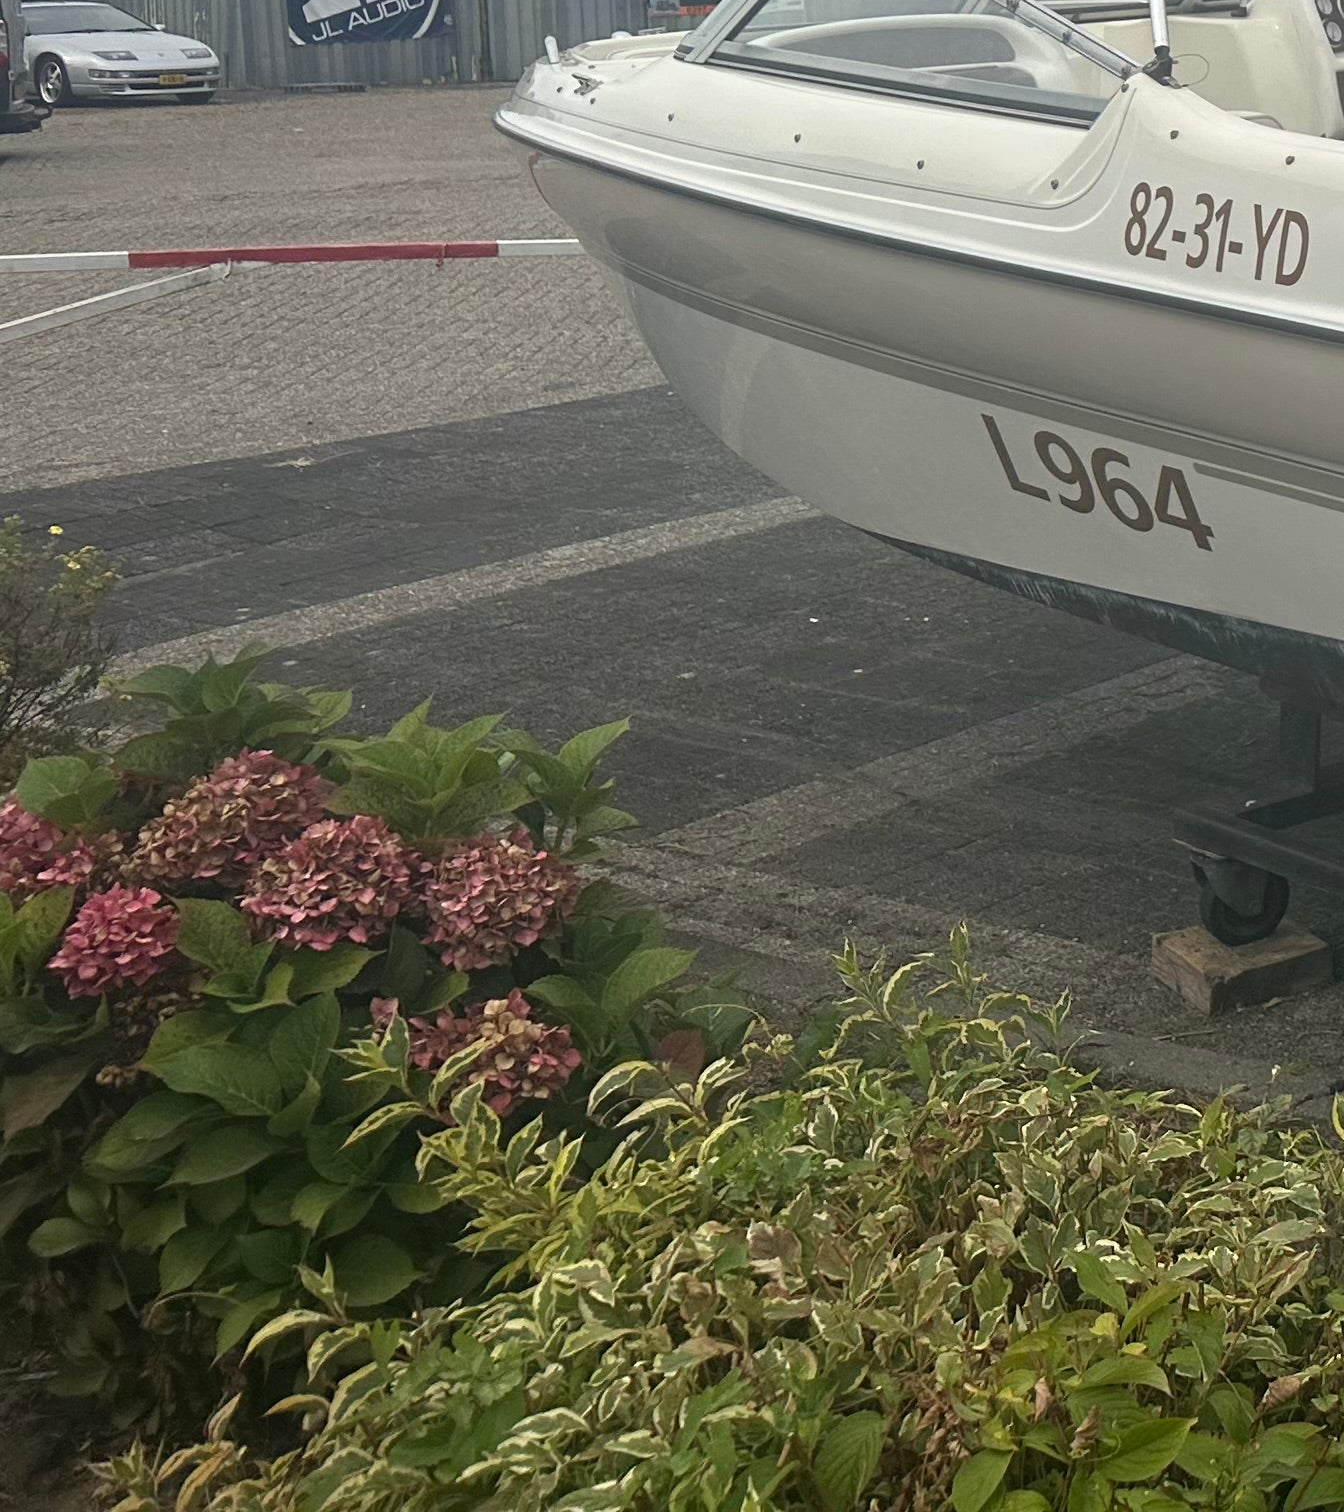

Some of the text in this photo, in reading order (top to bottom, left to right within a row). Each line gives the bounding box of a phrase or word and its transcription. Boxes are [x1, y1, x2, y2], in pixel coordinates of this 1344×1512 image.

[312, 21, 344, 42] JL
[1123, 181, 1310, 287] 82-31-YD
[980, 413, 1216, 553] L964
